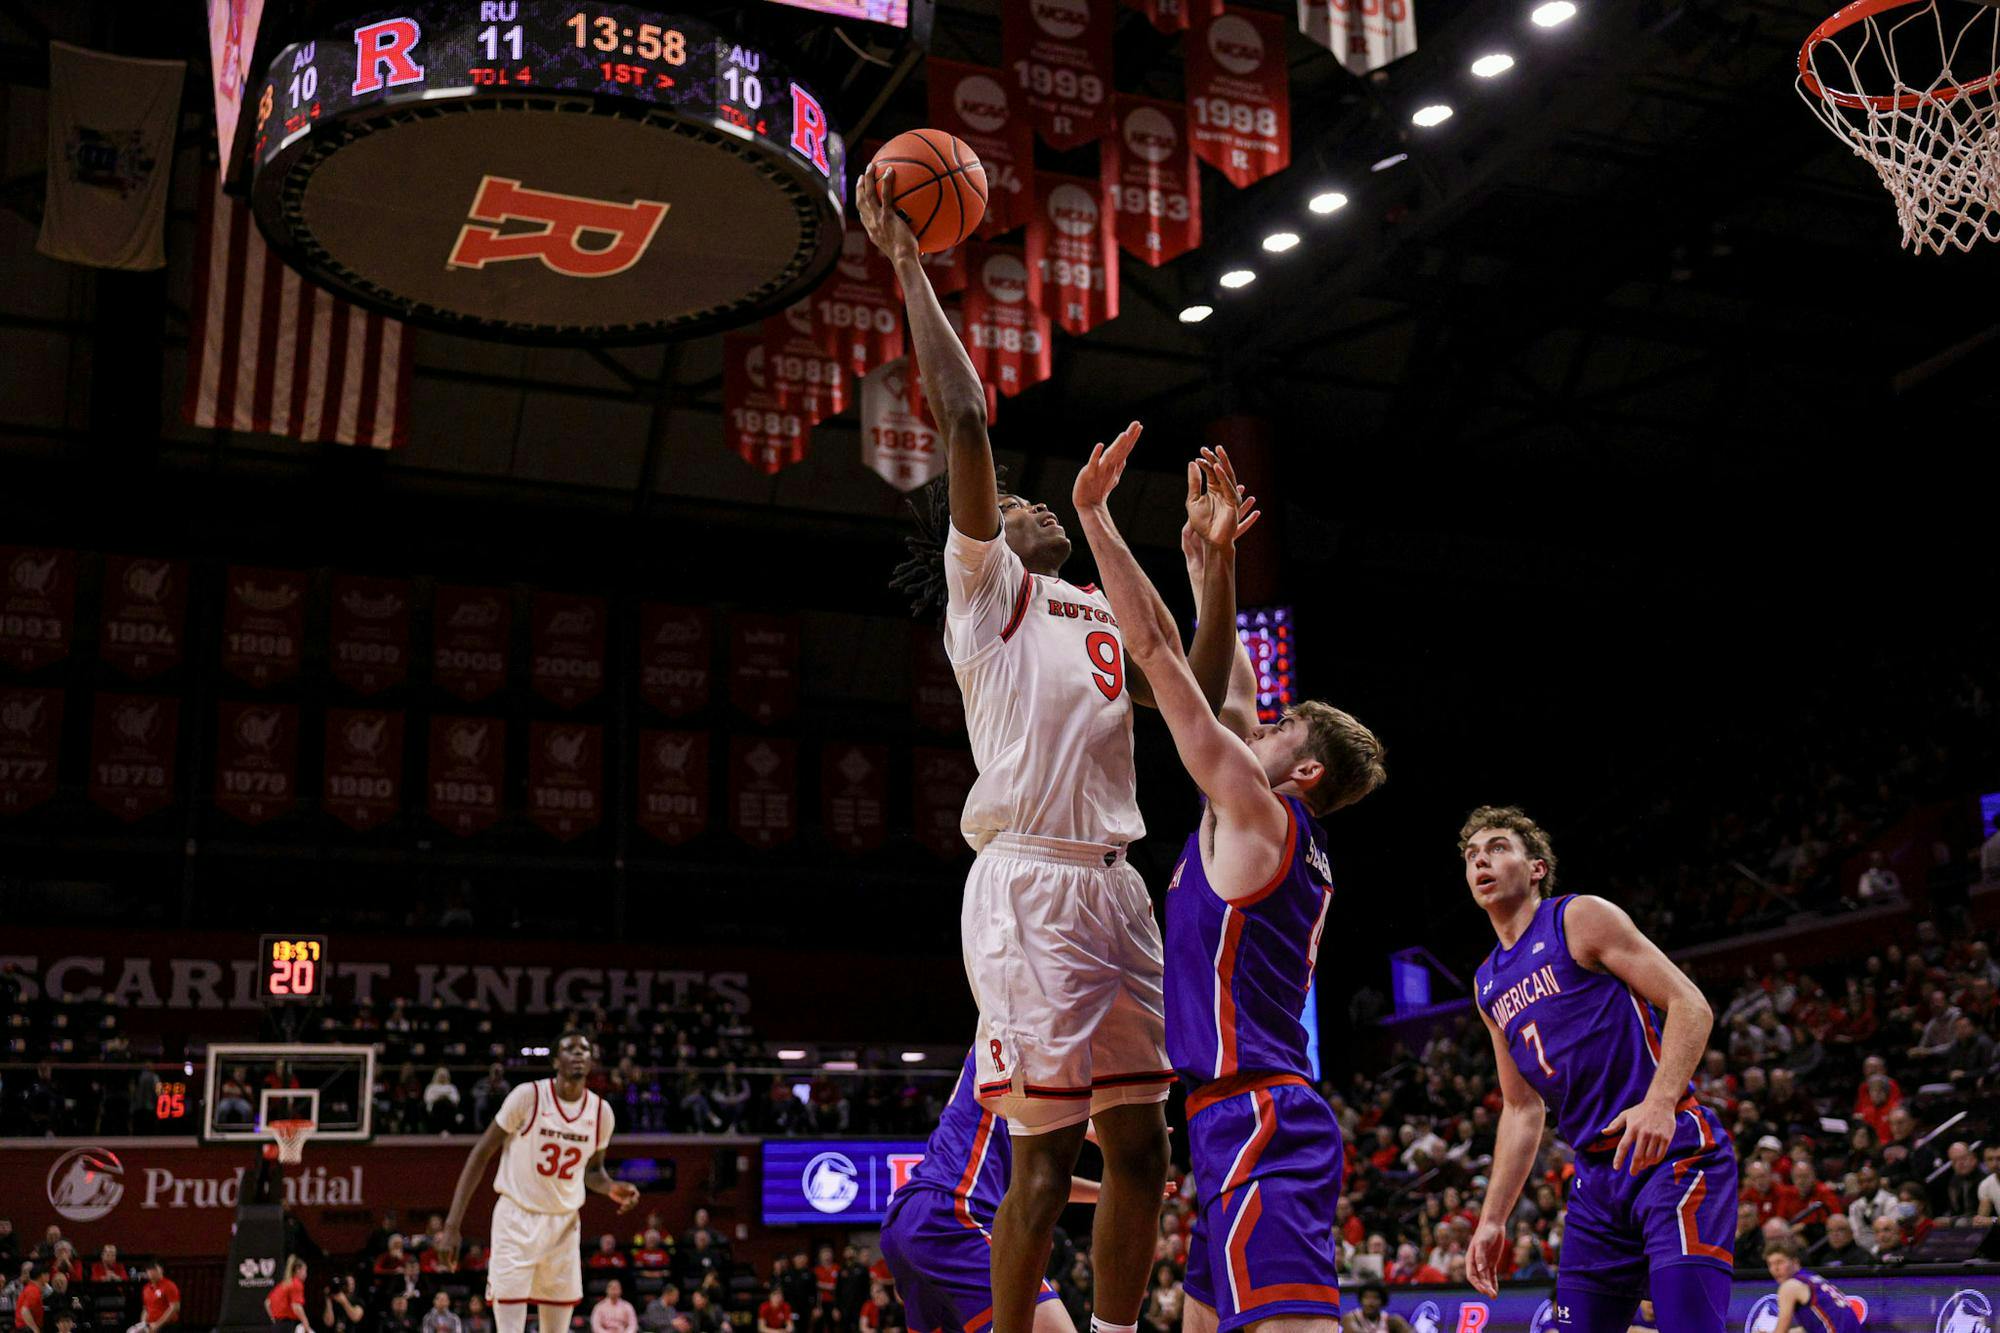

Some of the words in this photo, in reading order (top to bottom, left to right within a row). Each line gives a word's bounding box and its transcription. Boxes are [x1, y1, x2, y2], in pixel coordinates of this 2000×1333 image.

[480, 0, 519, 22] RU
[292, 40, 316, 73] AU
[352, 16, 425, 97] R
[478, 24, 524, 61] 11
[566, 11, 686, 67] 13:58
[515, 65, 533, 86] 4
[600, 61, 649, 86] 1ST
[729, 43, 760, 73] AU
[288, 65, 318, 109] 10
[722, 66, 762, 110] 10
[1013, 58, 1103, 105] 1999
[789, 80, 831, 178] R
[1053, 115, 1073, 136] R
[1193, 96, 1278, 138] 1998
[1109, 183, 1190, 223] 1993
[447, 174, 672, 278] R
[1037, 257, 1104, 292] 1991
[818, 300, 896, 335] 1990
[968, 322, 1042, 355] 1989
[871, 427, 936, 453] 1982
[1086, 631, 1123, 702] 9
[272, 940, 322, 962] 13:57
[0, 955, 391, 1010] SCARLT
[414, 962, 752, 1017] KNIGHTS
[269, 959, 315, 995] 20
[990, 1039, 1006, 1073] R
[1519, 1019, 1556, 1079] 7
[155, 1094, 186, 1119] 05
[536, 1143, 582, 1180] 32
[140, 1164, 365, 1210] Prudntial
[1456, 1302, 1491, 1333] R
